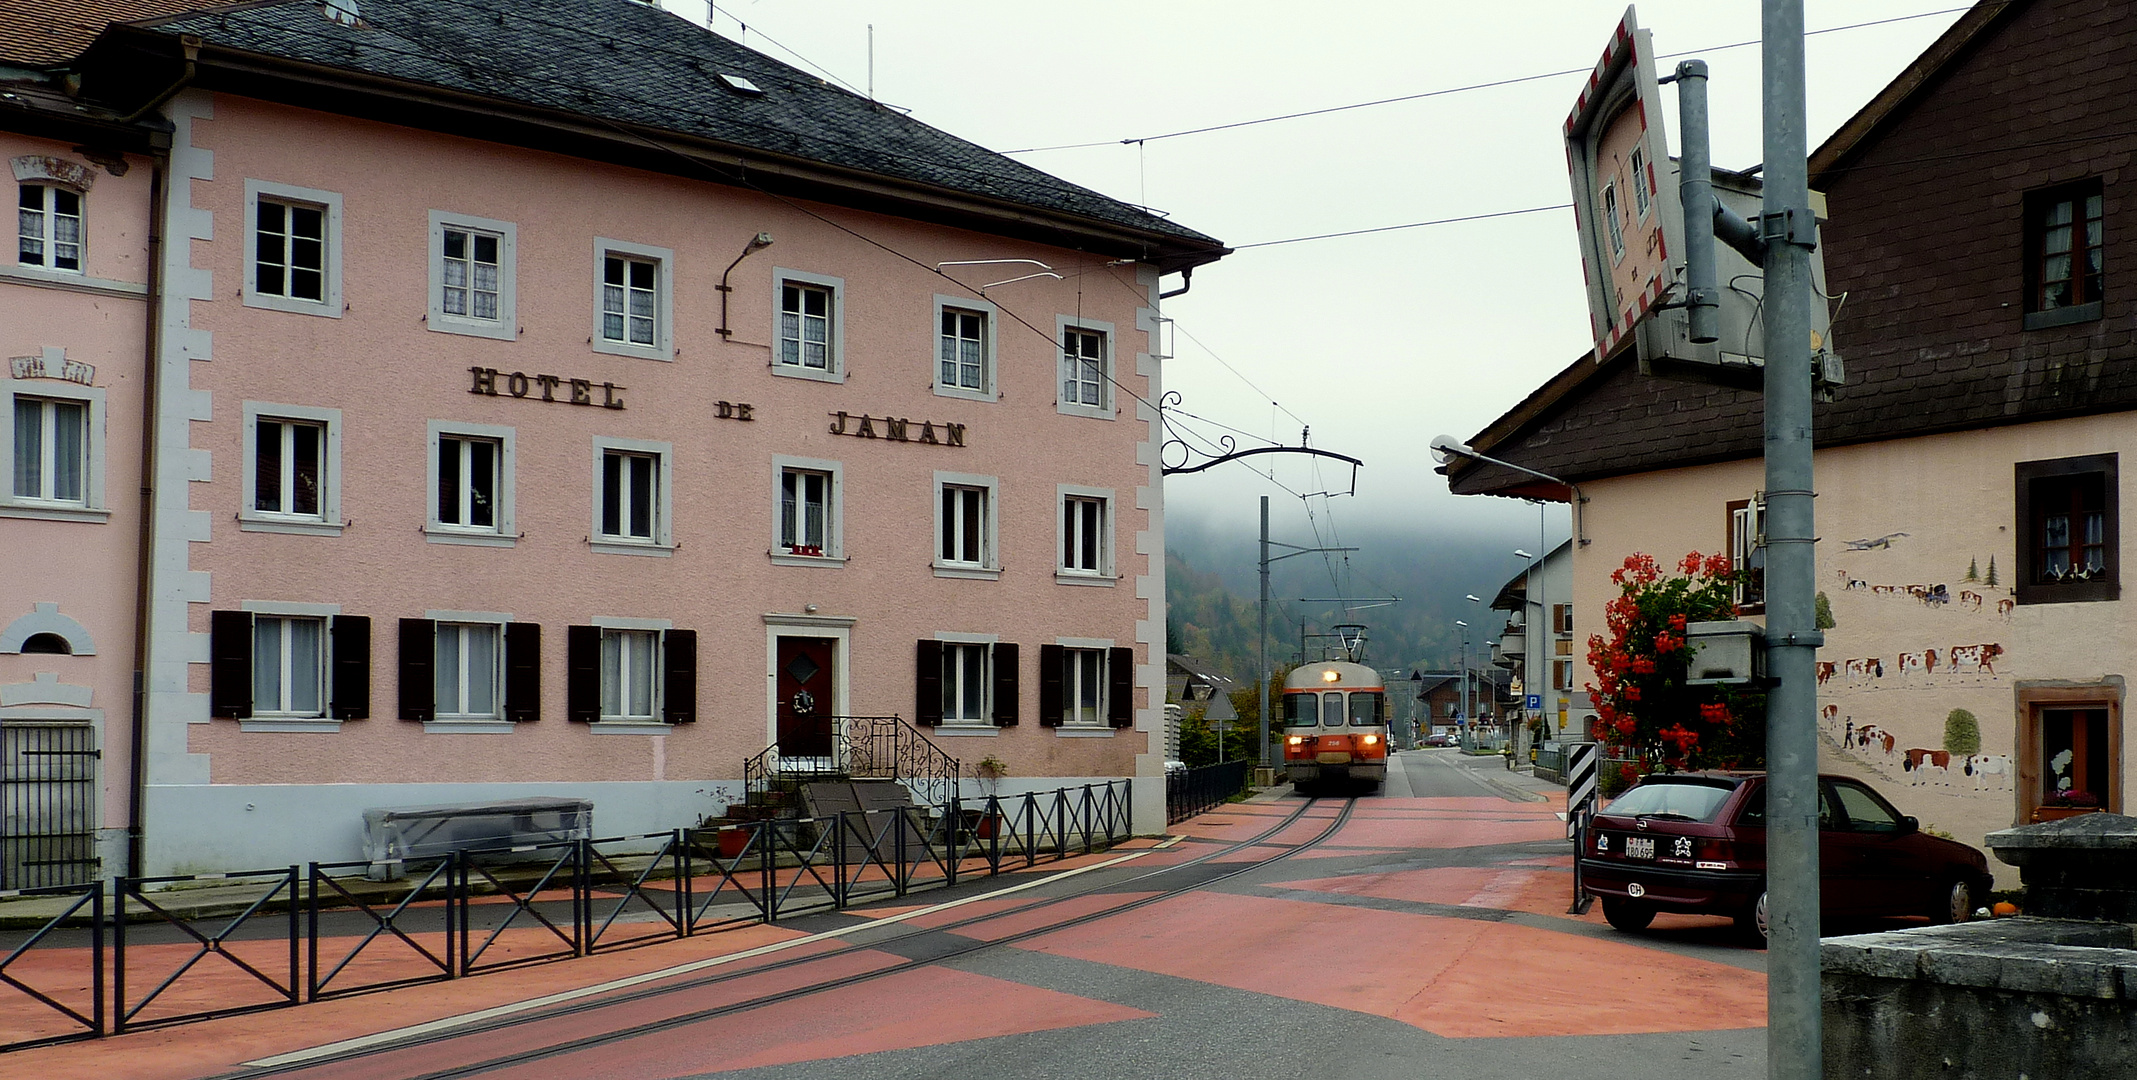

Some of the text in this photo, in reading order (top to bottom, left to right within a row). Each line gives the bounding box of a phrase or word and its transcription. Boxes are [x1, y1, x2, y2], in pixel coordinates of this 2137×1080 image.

[471, 366, 967, 447] HOTEL DE JAMAN
[1630, 885, 1641, 895] CH
